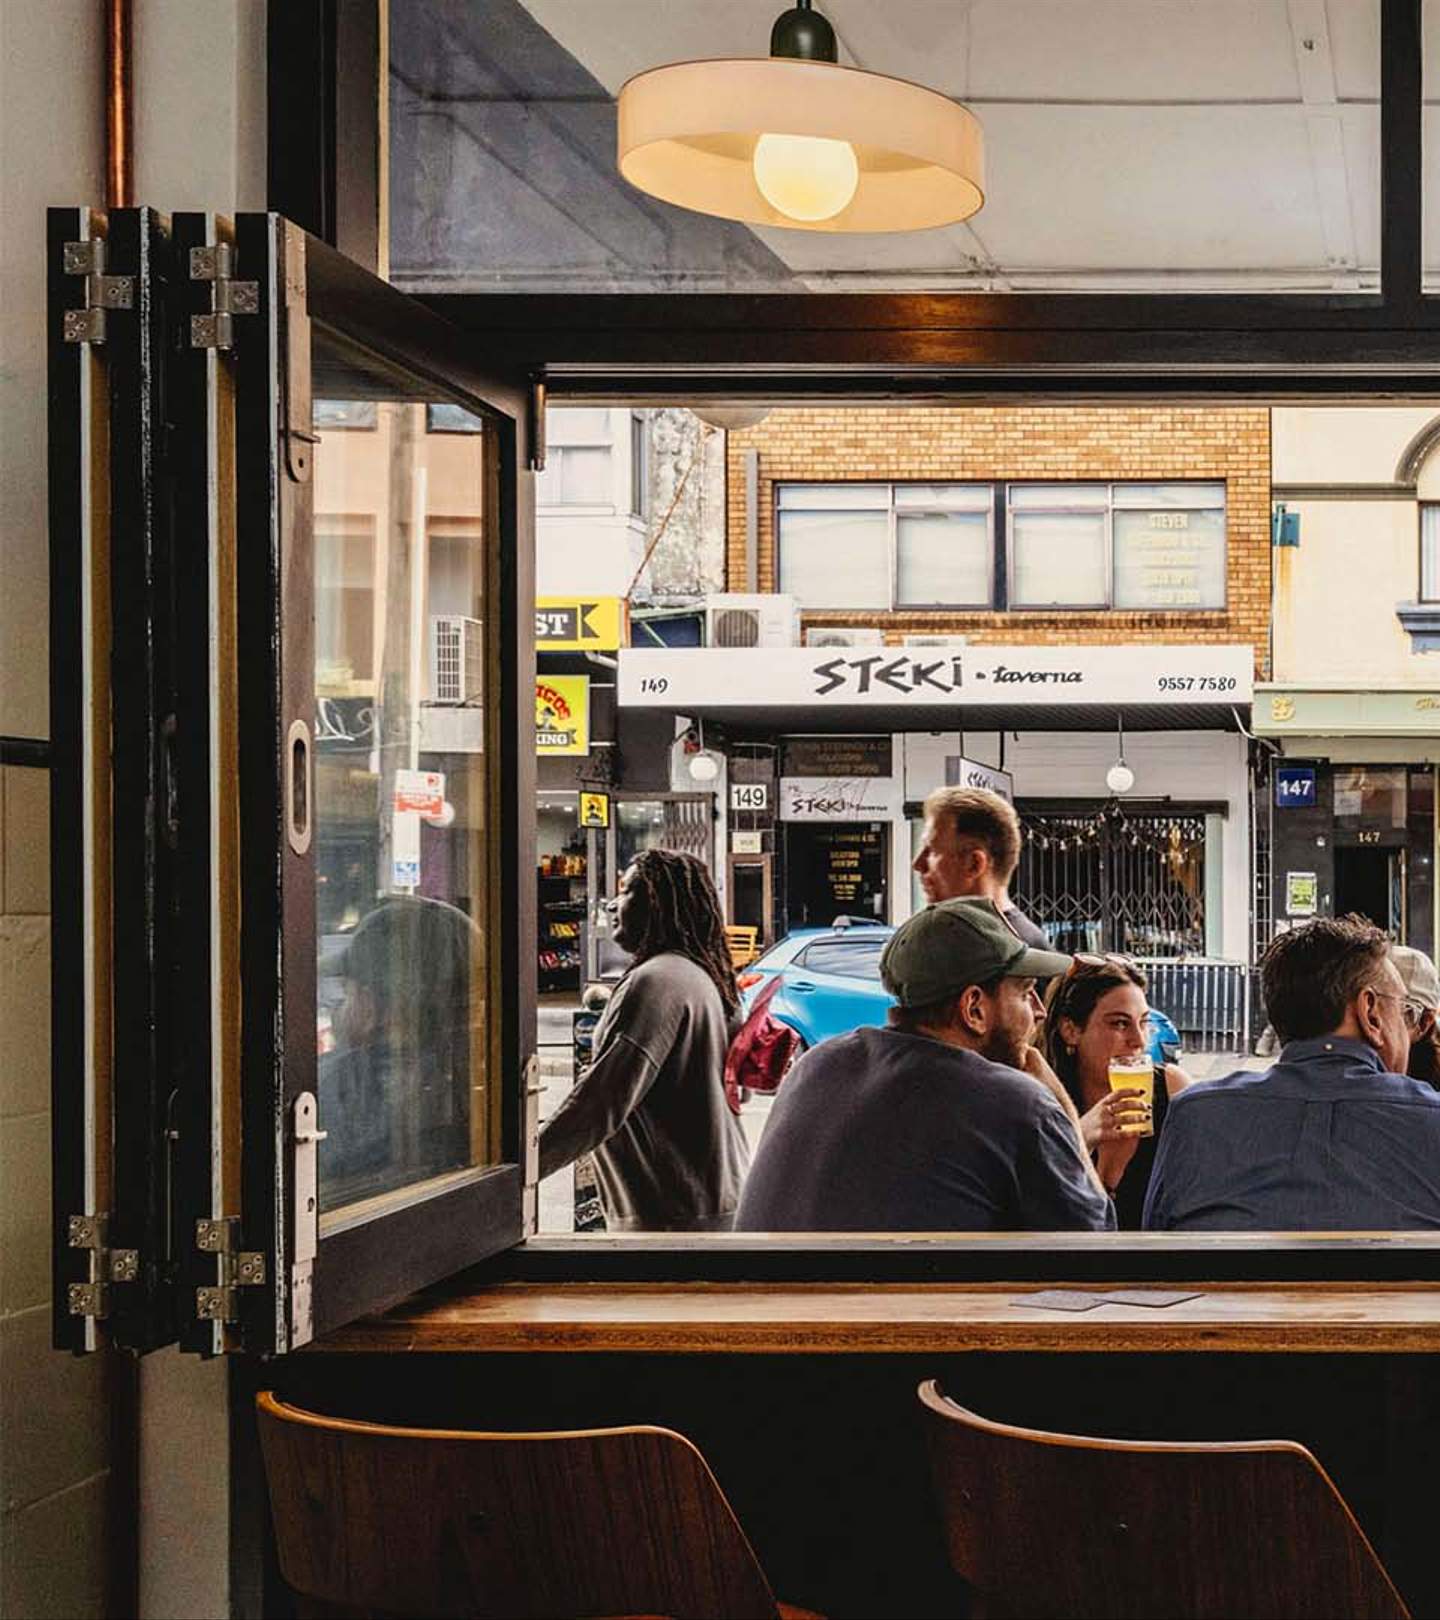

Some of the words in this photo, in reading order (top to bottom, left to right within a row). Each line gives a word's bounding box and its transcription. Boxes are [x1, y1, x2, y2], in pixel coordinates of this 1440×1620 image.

[536, 613, 568, 635] ST
[992, 665, 1083, 684] taverna
[641, 678, 668, 693] 149
[1158, 677, 1195, 692] 9557
[1199, 677, 1237, 691] 7580
[1280, 780, 1312, 796] 147
[733, 788, 764, 807] 149
[1358, 832, 1380, 843] 147
